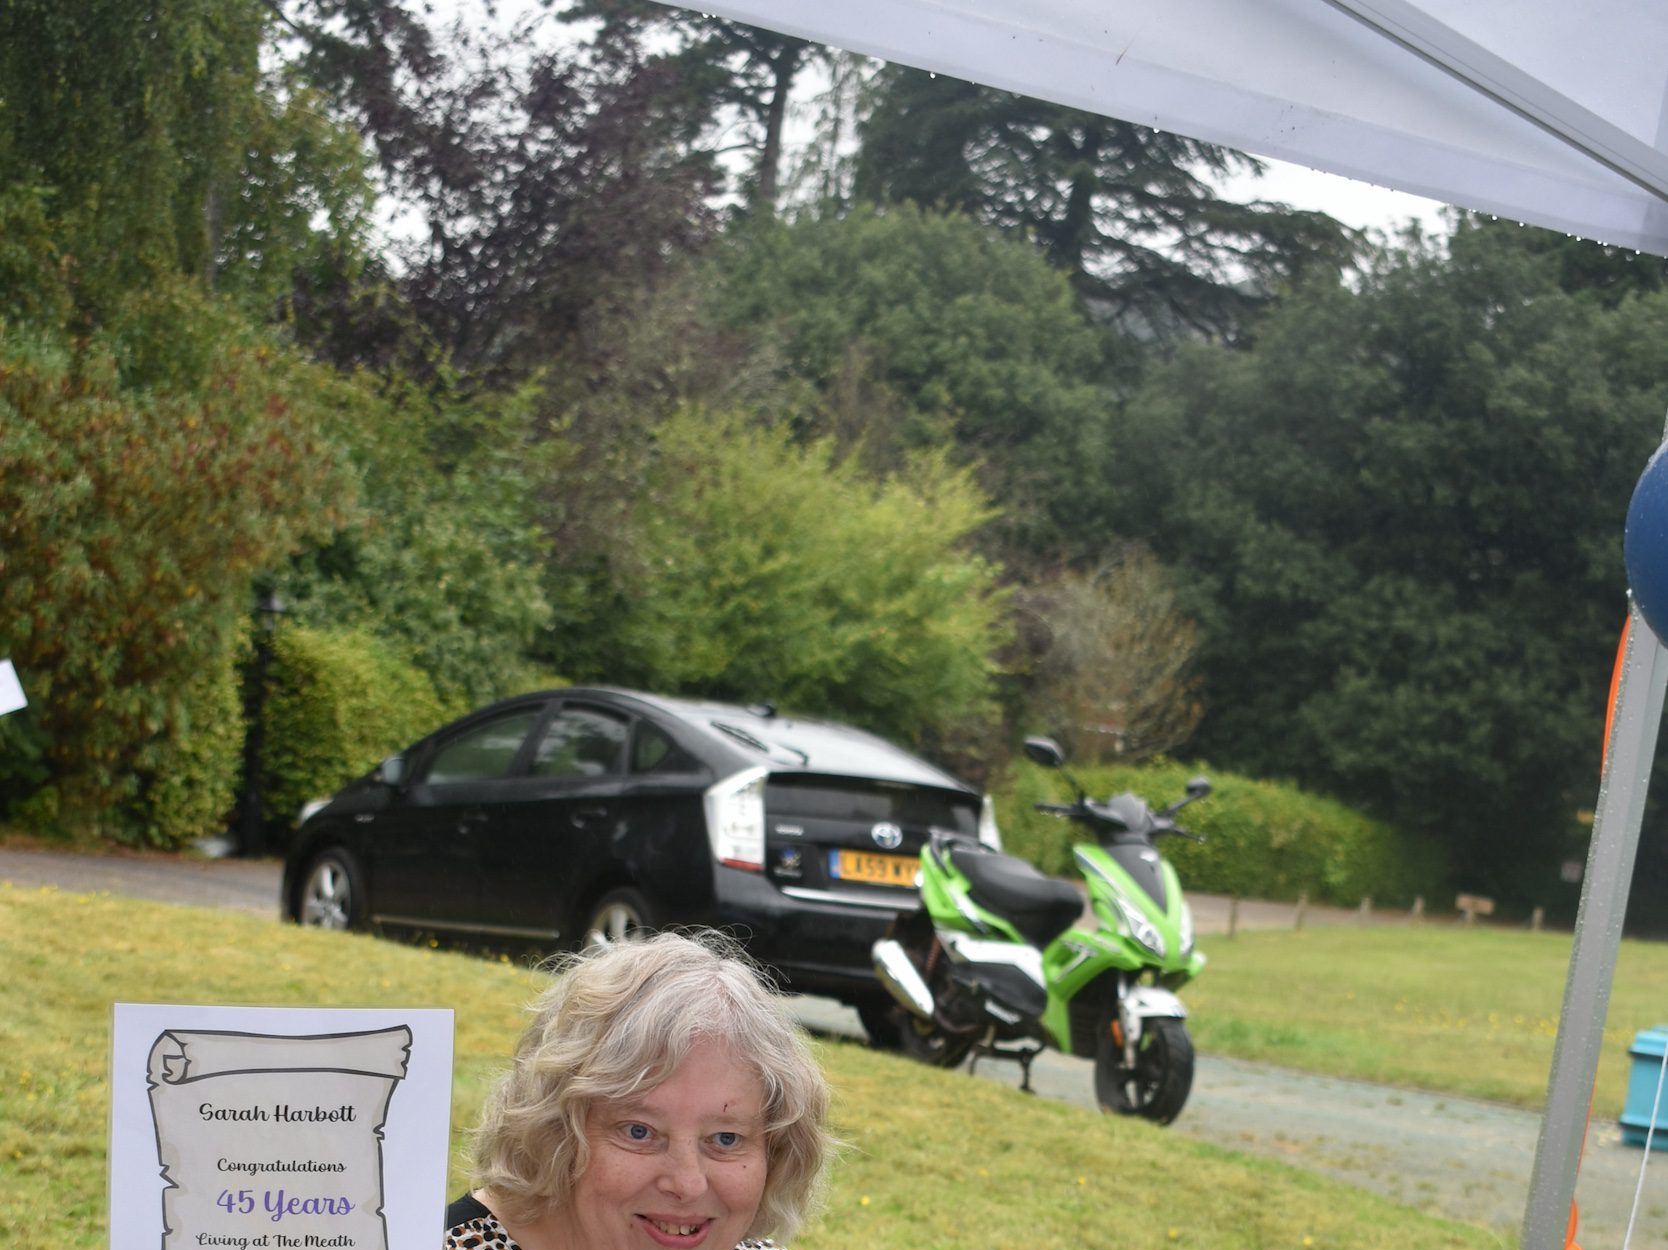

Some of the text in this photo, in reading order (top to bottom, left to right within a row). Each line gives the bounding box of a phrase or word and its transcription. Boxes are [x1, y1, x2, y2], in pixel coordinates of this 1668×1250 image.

[199, 1102, 357, 1123] Sarah Harbott
[216, 1158, 347, 1176] Congratulations
[216, 1189, 356, 1222] 45 Years
[195, 1232, 356, 1250] Living at The Meath
